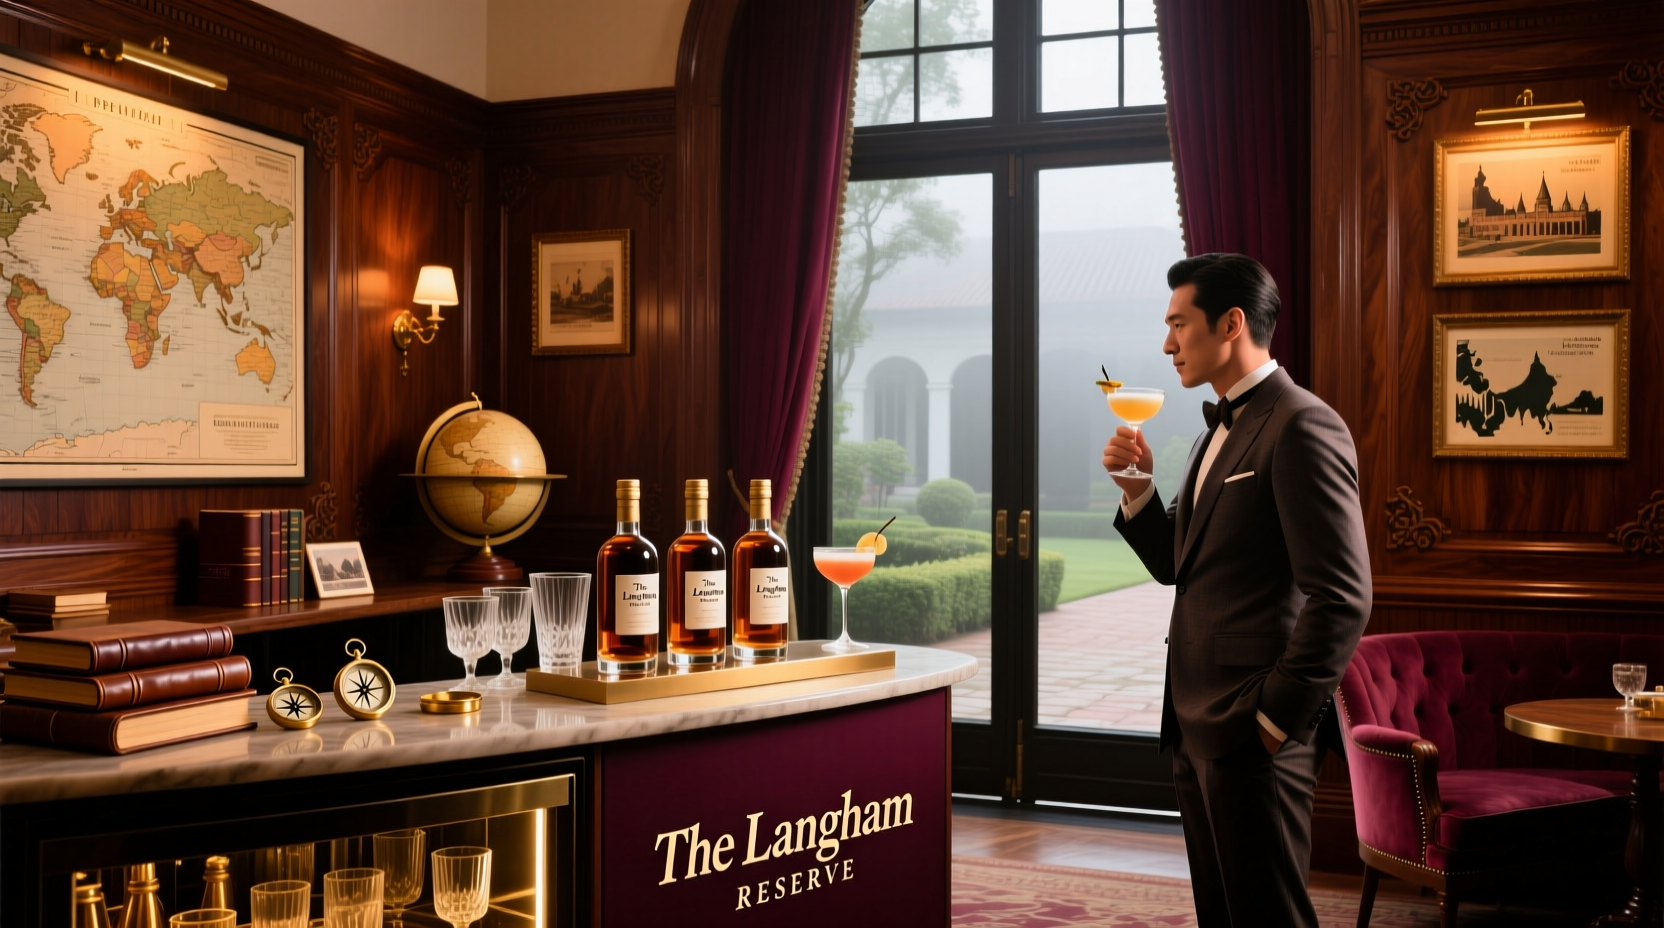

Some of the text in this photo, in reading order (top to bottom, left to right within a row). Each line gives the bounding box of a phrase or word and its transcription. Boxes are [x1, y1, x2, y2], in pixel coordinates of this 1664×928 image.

[655, 789, 914, 886] The Langham
[736, 859, 854, 911] RESERVE
